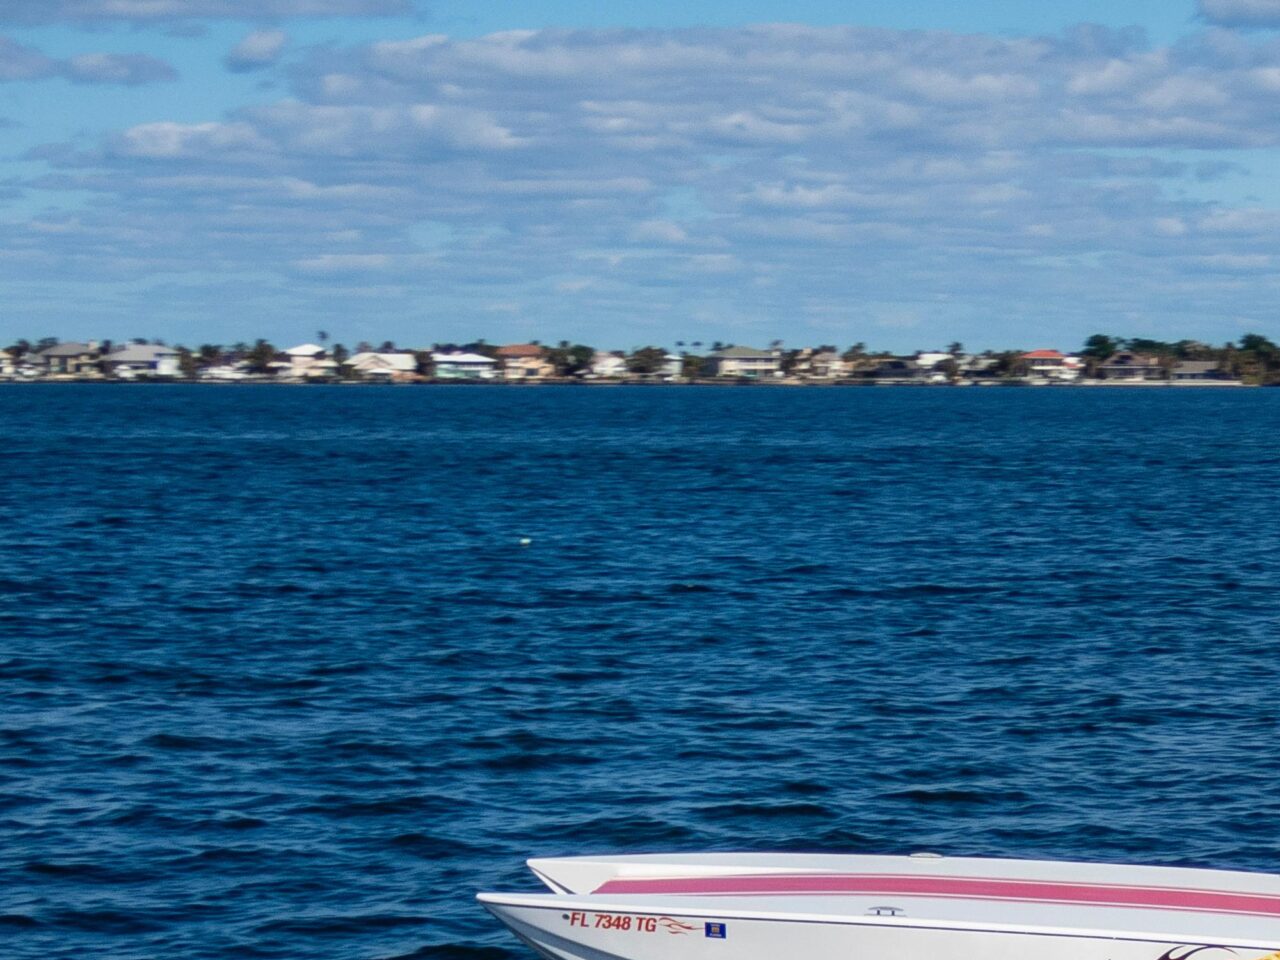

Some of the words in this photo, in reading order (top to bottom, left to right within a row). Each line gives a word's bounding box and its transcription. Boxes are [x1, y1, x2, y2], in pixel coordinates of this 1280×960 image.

[570, 912, 590, 928] FL
[595, 914, 631, 931] 7348
[636, 917, 657, 932] TG
